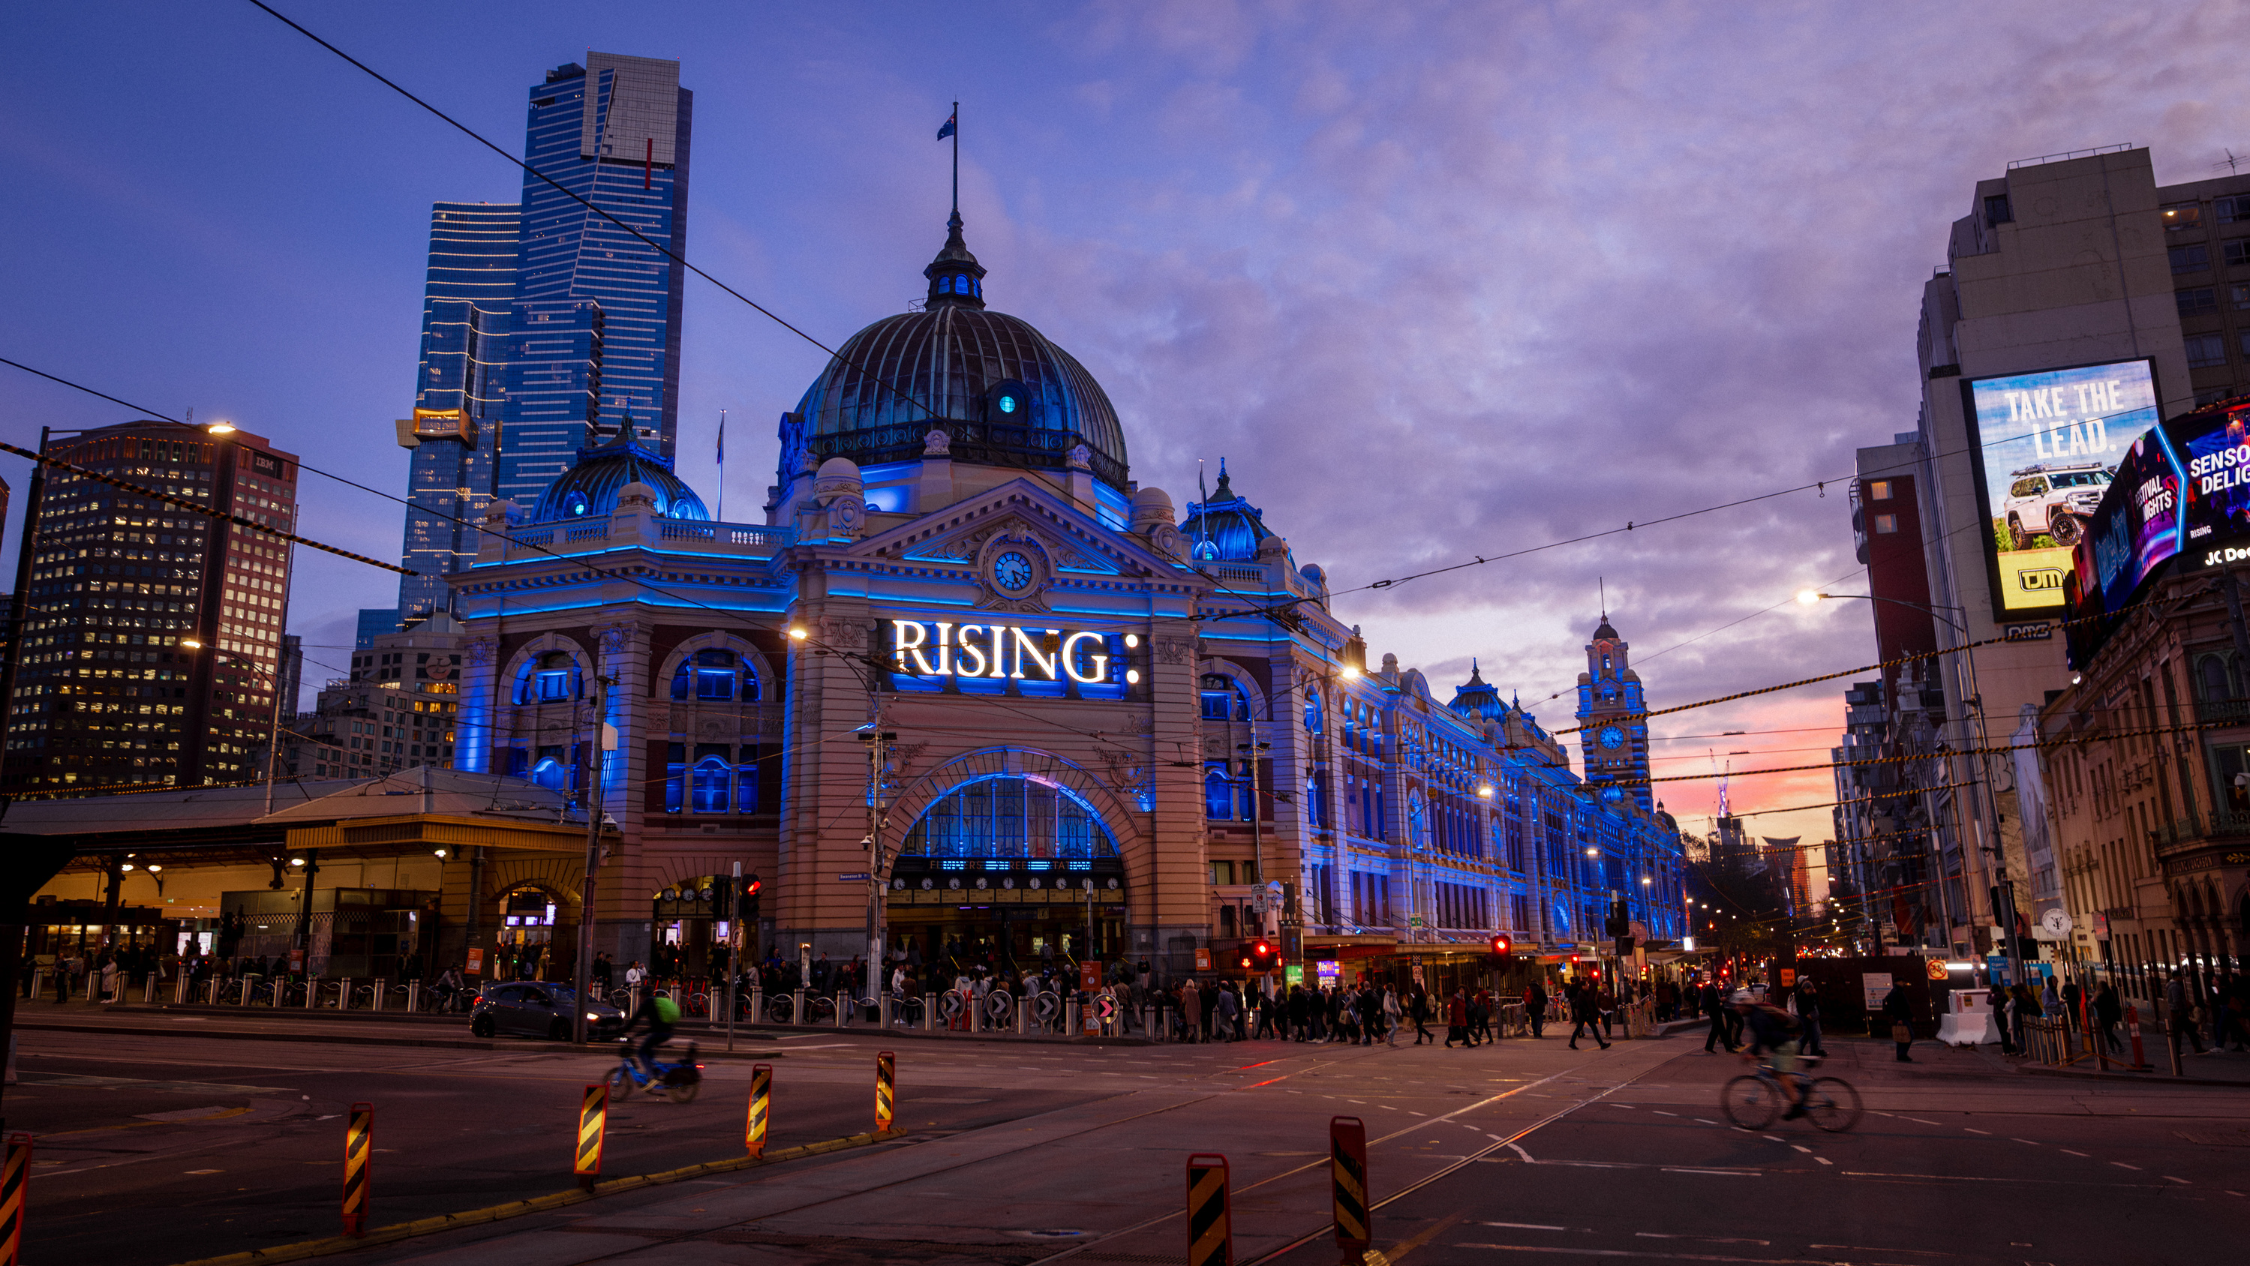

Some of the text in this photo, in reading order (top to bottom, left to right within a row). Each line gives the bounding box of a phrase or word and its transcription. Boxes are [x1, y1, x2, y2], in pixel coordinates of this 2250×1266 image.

[2004, 380, 2124, 421] TAKE THE
[2032, 417, 2117, 459] LEAD.
[255, 456, 274, 471] IBM
[2190, 444, 2250, 478] SENSO
[2135, 474, 2163, 510] FESTIVAL
[2142, 490, 2172, 523] NIGHTS
[2190, 525, 2212, 539] RISING
[2205, 550, 2222, 566] JC
[1044, 635, 1058, 643] CUT
[1045, 643, 1058, 651] OFF
